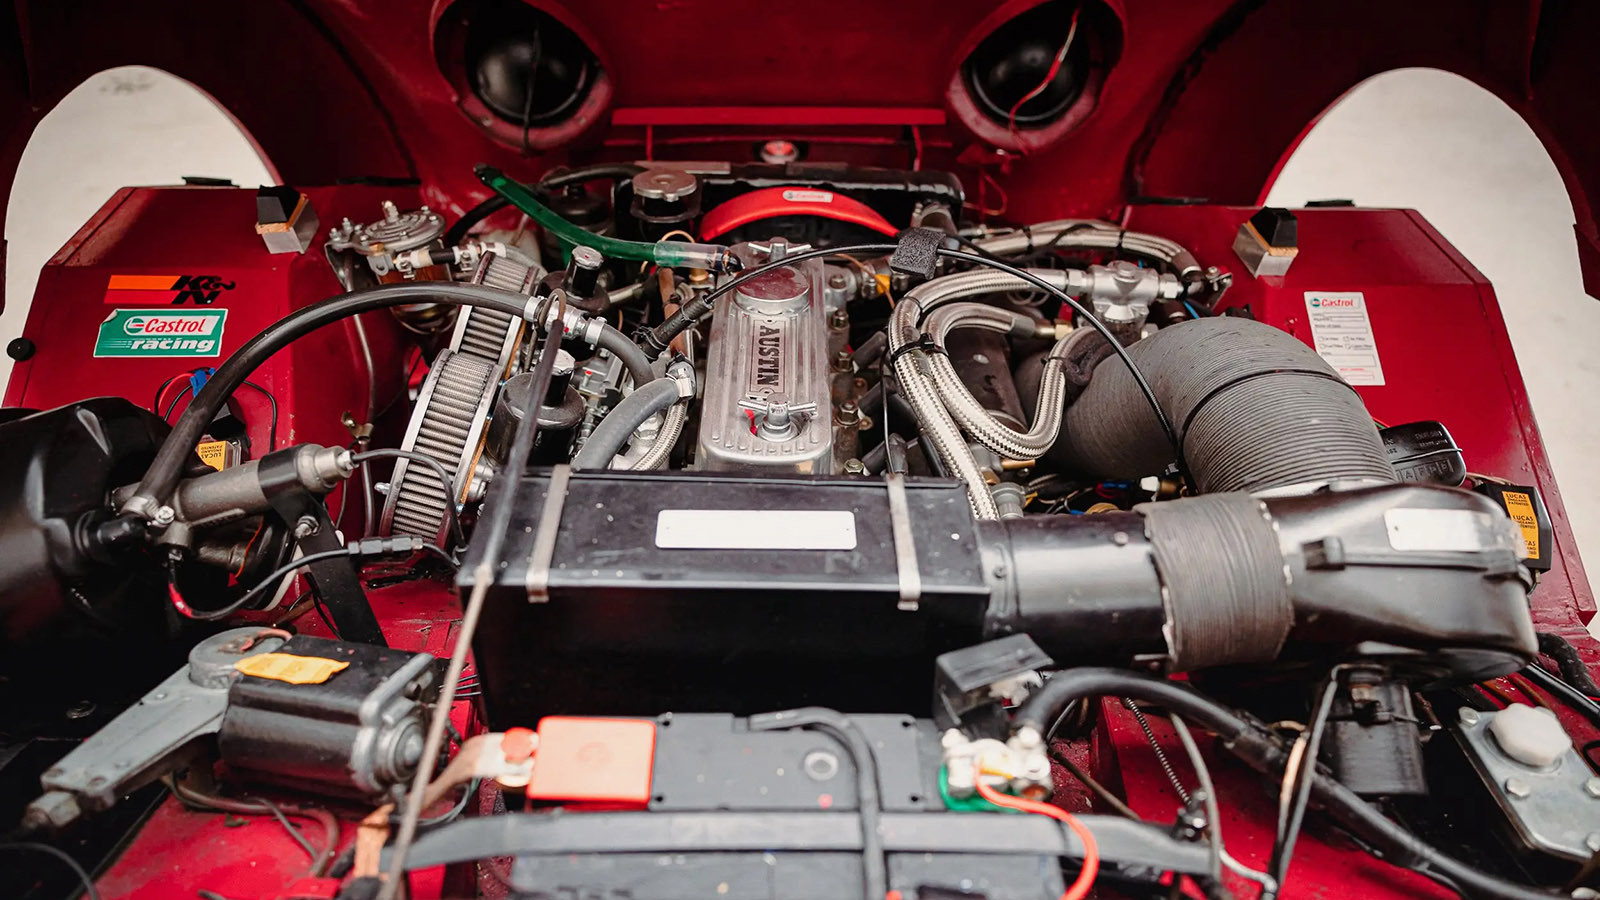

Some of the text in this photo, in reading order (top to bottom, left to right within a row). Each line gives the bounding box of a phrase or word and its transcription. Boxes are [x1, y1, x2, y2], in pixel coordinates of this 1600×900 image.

[1321, 299, 1354, 307] Castrol
[144, 318, 207, 333] Castrol
[131, 337, 216, 352] racing
[757, 325, 780, 386] AUSTIN
